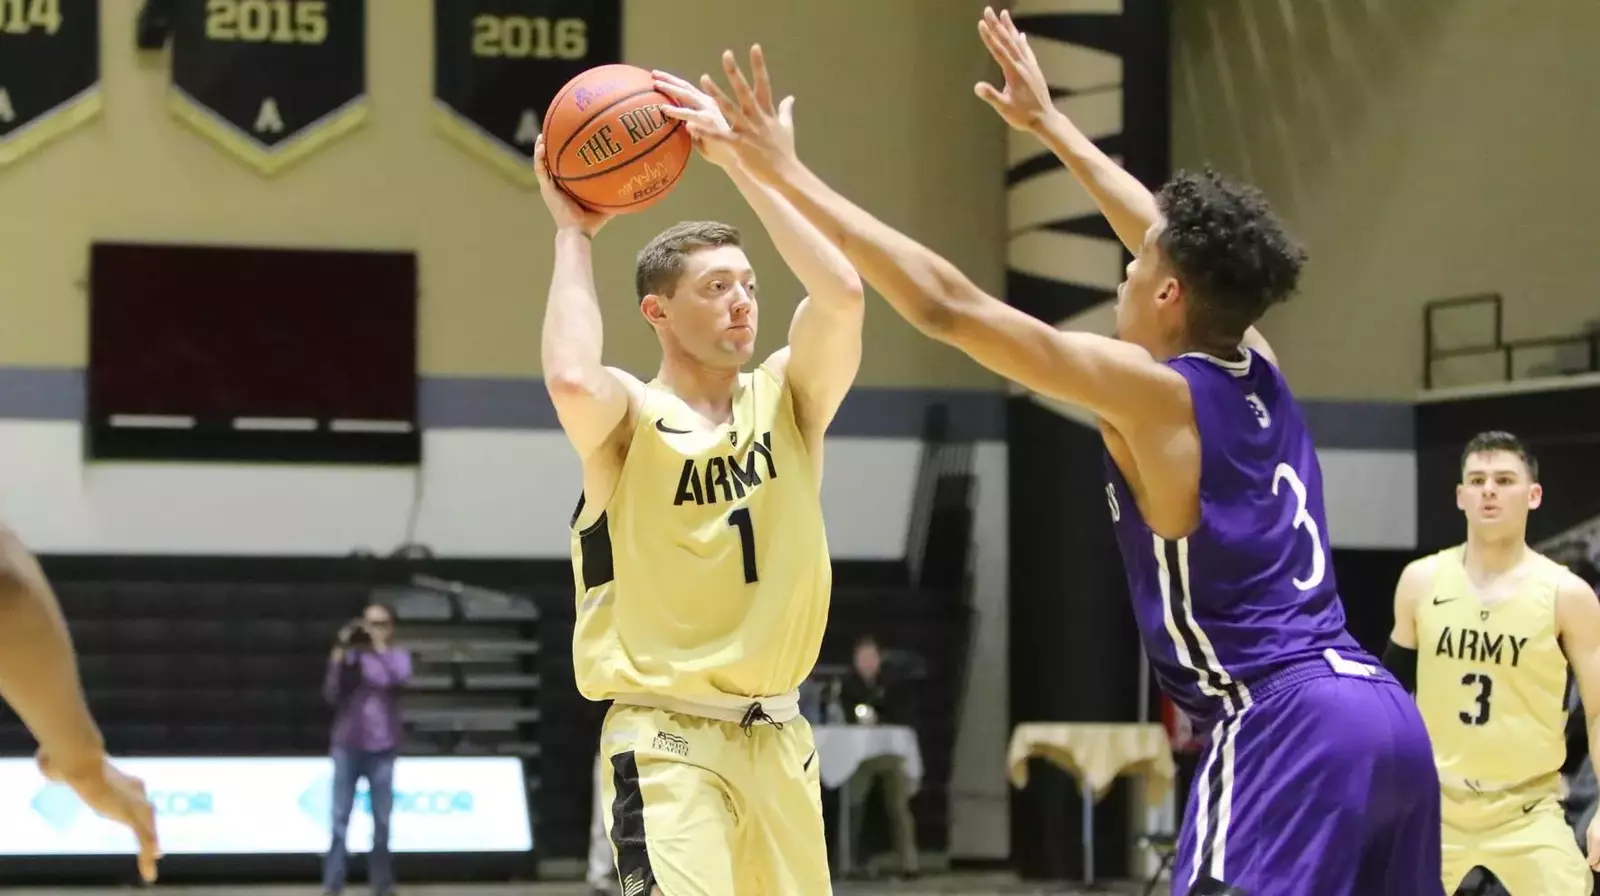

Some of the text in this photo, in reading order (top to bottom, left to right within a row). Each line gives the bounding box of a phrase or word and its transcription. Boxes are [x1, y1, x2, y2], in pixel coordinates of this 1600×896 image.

[0, 0, 63, 35] 14
[205, 0, 328, 44] 2015
[471, 16, 588, 59] 2016
[254, 98, 284, 132] A
[576, 125, 622, 168] THE
[633, 175, 670, 199] ROCK
[673, 431, 777, 506] ARMY
[728, 507, 759, 584] 1
[1272, 462, 1325, 591] 3
[1435, 626, 1529, 667] ARMY
[1458, 673, 1494, 726] 3
